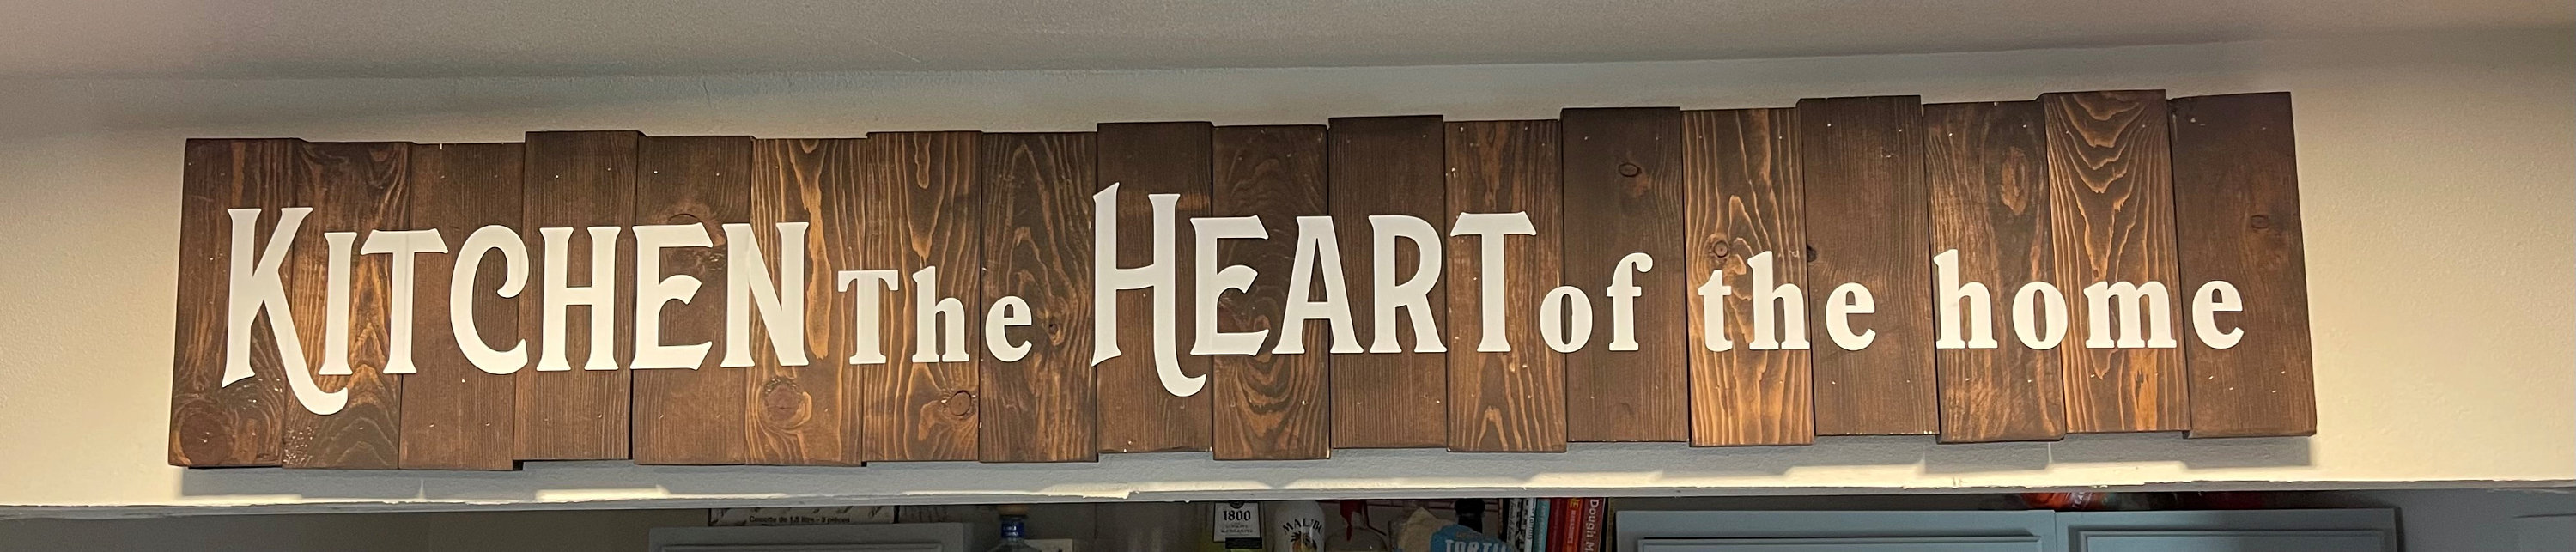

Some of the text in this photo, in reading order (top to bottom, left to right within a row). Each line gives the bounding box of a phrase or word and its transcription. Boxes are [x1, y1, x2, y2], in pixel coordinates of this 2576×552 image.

[221, 181, 2245, 416] KITCHEN The HEART of the home
[1223, 510, 1251, 521] 1800
[1584, 499, 1600, 552] Dough M
